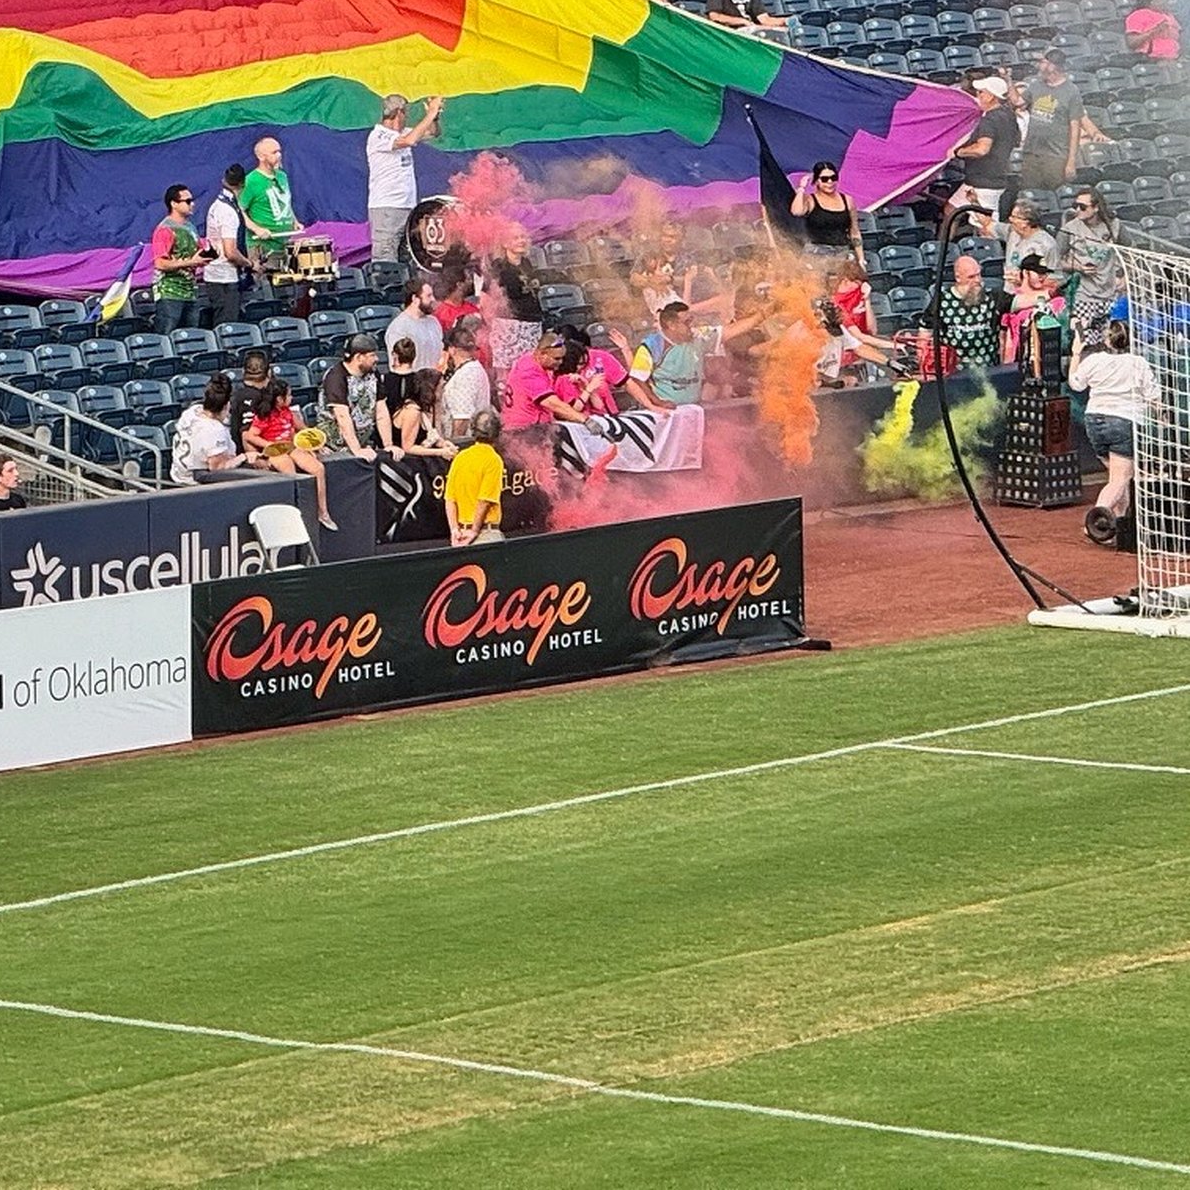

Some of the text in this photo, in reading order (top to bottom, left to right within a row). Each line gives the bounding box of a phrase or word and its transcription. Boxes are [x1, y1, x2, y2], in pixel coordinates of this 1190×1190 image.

[71, 525, 270, 600] uscellula
[628, 537, 780, 636] Osage
[204, 595, 382, 699] Osage
[421, 564, 591, 666] Osage
[456, 628, 602, 665] CASINO HOTEL
[658, 600, 791, 636] CASINO HOTEL
[13, 668, 43, 708] of
[48, 655, 187, 702] Oklahoma
[240, 661, 395, 698] CASINO HOTEL
